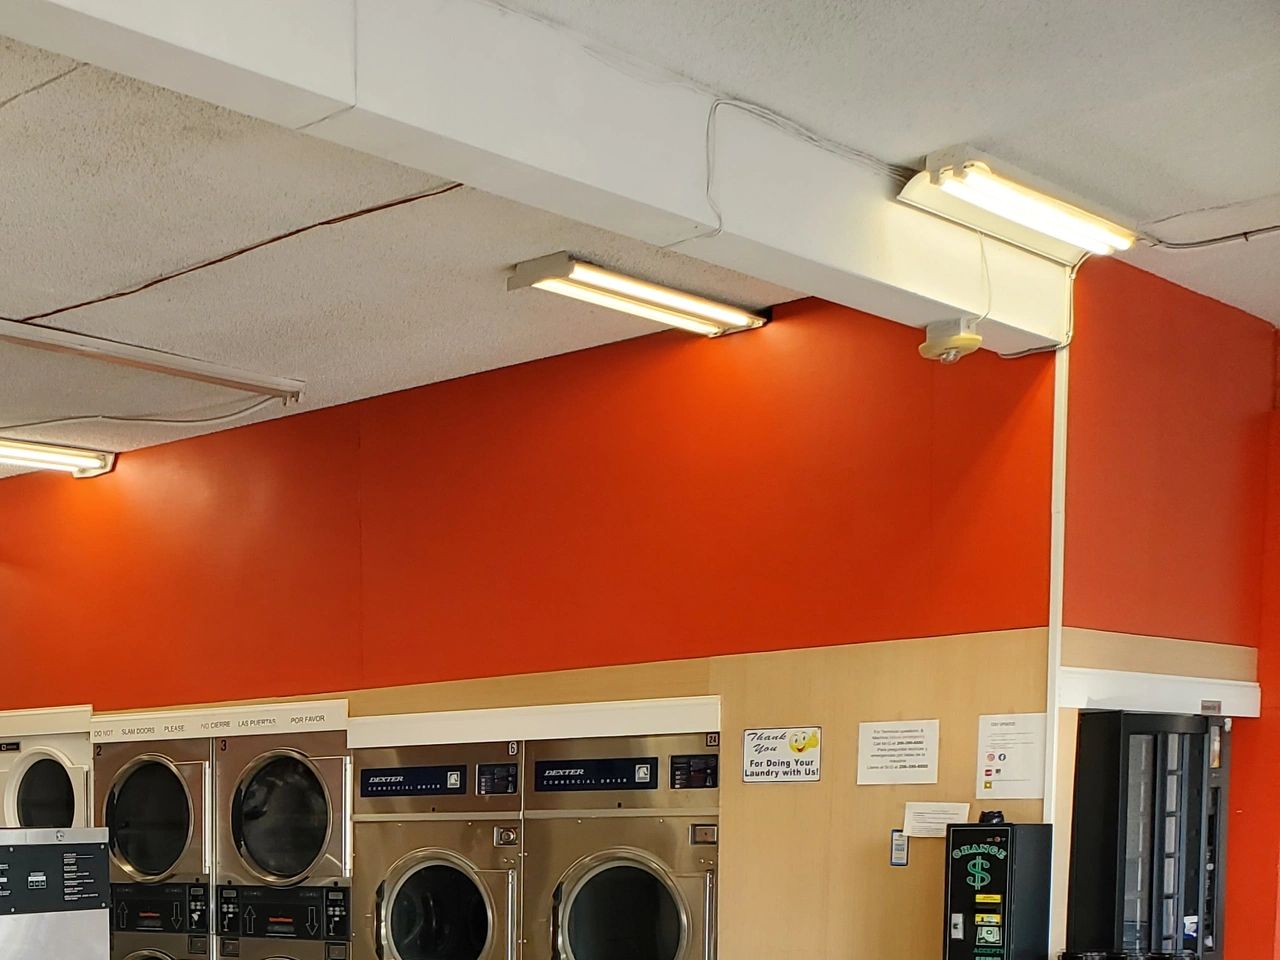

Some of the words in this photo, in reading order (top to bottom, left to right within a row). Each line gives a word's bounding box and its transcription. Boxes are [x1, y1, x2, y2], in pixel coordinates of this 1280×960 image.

[103, 729, 113, 737] NOT
[121, 728, 135, 736] SLAM
[136, 727, 155, 735] DOORS
[163, 724, 185, 733] PLEASE
[237, 719, 249, 728] LAS
[249, 718, 277, 727] PUERTAS
[290, 716, 303, 724] POR
[304, 714, 326, 723] FAVOR
[708, 734, 717, 744] 24
[747, 731, 787, 742] Thank
[96, 745, 102, 756] 2
[220, 739, 227, 751] 3
[509, 742, 517, 755] 6
[752, 743, 778, 755] You
[749, 759, 764, 768] For
[766, 759, 791, 769] Doing
[794, 758, 814, 767] Your
[744, 768, 780, 779] Laundry
[781, 768, 802, 776] with
[804, 767, 819, 776] Us!
[952, 843, 1008, 860] CHANGE
[966, 855, 991, 890] $
